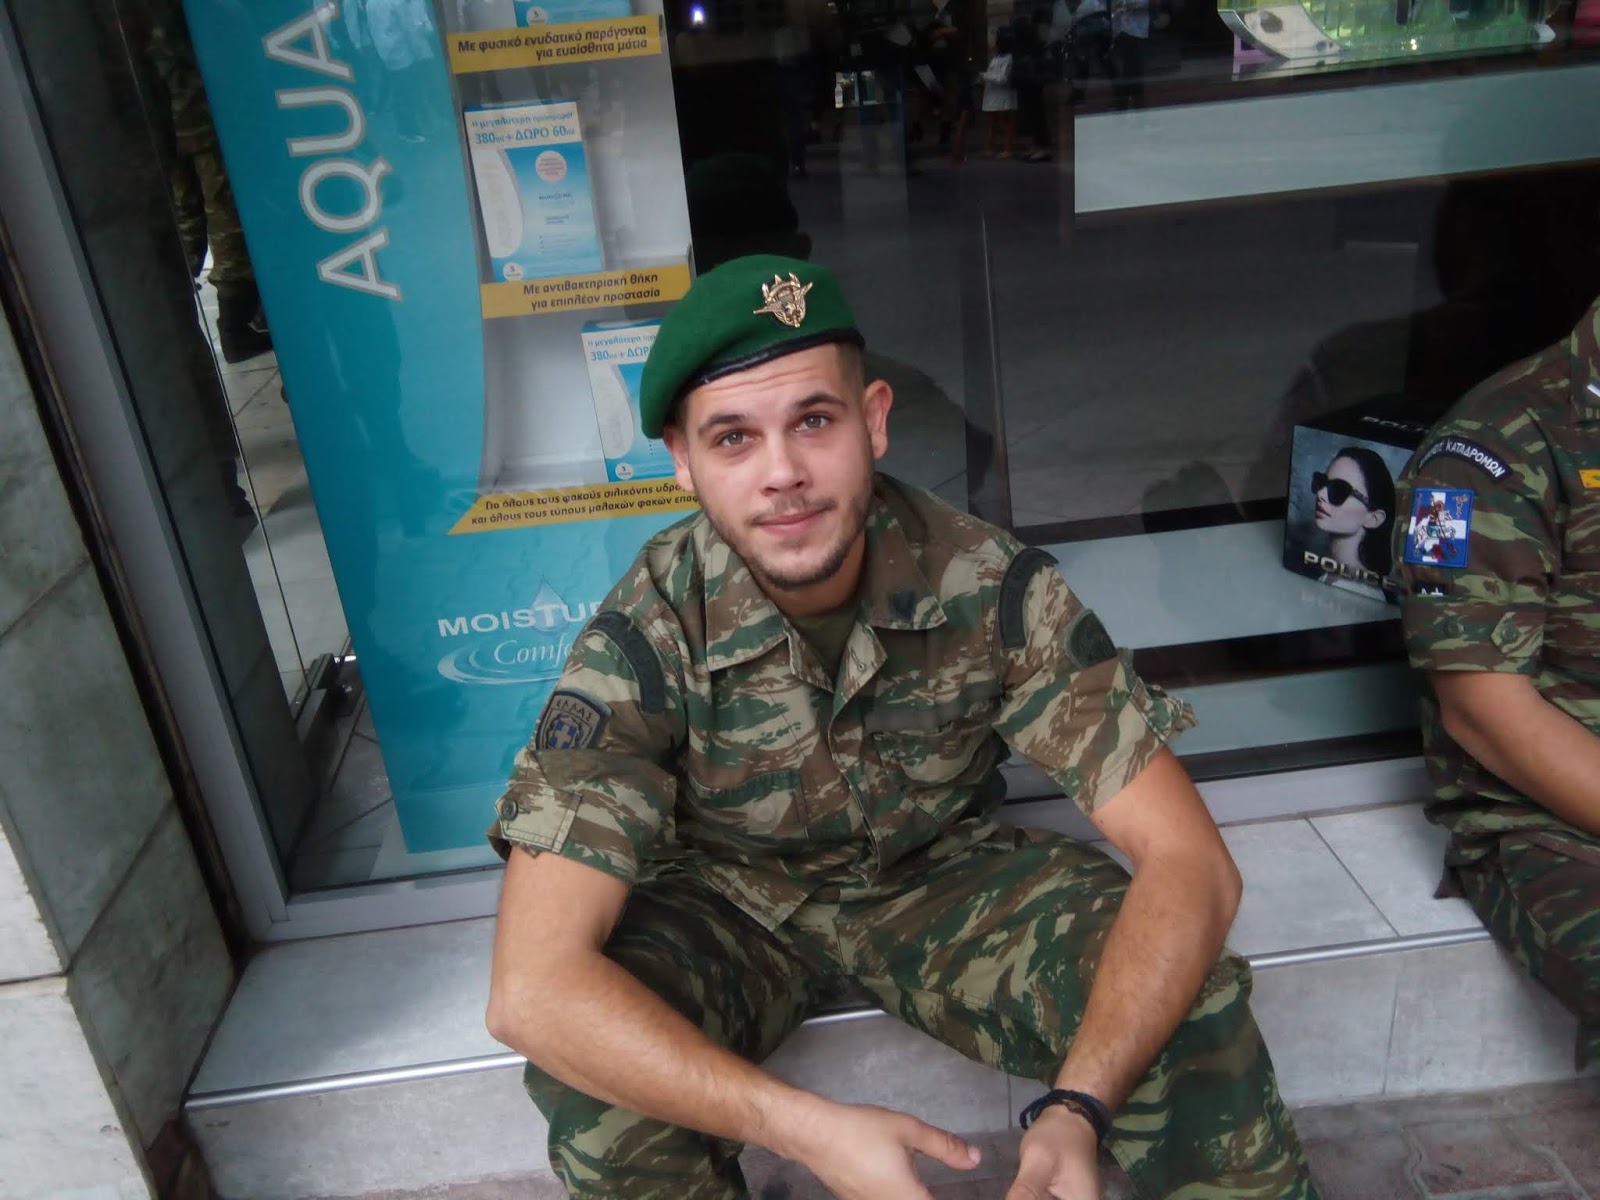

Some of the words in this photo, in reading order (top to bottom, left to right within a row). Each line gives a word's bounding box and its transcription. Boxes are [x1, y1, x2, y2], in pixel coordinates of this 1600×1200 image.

[458, 40, 476, 53] Με
[479, 36, 521, 54] φυσικό
[524, 30, 582, 46] ενυδατικό
[585, 25, 646, 41] παράγοντα
[536, 47, 553, 61] για
[556, 41, 615, 57] ευαίσθητα
[618, 38, 648, 55] μάτια
[515, 127, 550, 141] ΔΩΡΟ
[262, 0, 402, 300] AQUA
[523, 284, 540, 295] Με
[543, 276, 627, 292] αντιβακτηριακή
[630, 273, 658, 285] θήκη
[531, 299, 547, 311] για
[550, 293, 600, 308] επιπλέον
[603, 288, 660, 304] προστασία
[627, 346, 650, 358] ΔΩΡ
[1445, 438, 1506, 478] ΚΑΤΑΔΡΟΜΩΝ
[485, 499, 500, 511] Για
[502, 495, 534, 510] όλους
[537, 492, 560, 505] τους
[562, 489, 601, 504] φακούς
[604, 484, 654, 499] σιλικόνης
[656, 481, 686, 494] υδρο
[472, 513, 487, 525] και
[490, 508, 522, 523] όλους
[524, 507, 547, 520] τους
[549, 502, 586, 517] τύπους
[589, 498, 635, 515] μαλακών
[637, 495, 673, 511] φακών
[556, 699, 593, 722] ΕΛΛΑΣ
